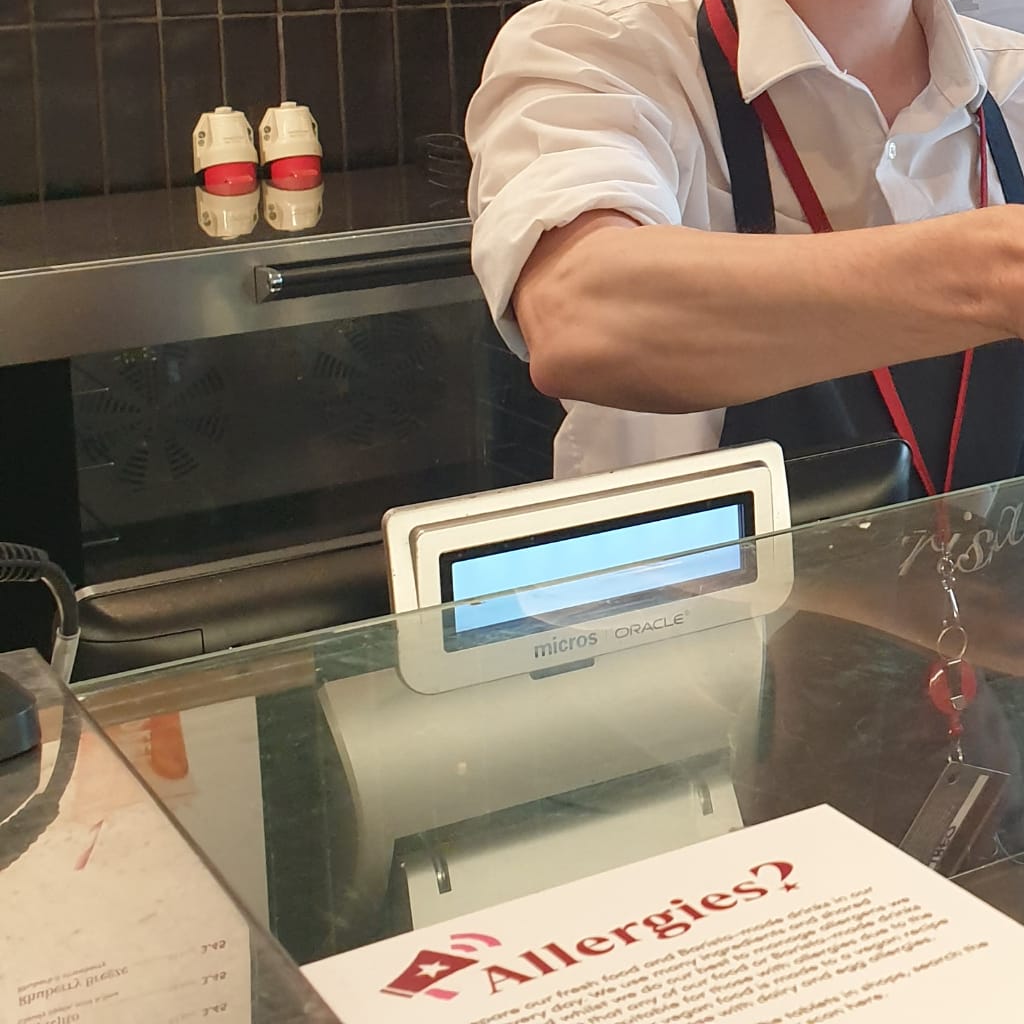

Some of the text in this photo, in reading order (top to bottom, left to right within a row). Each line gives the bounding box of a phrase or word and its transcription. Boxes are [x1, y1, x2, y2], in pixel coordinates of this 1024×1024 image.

[534, 632, 599, 659] micros
[481, 861, 799, 996] Allergies?
[525, 995, 553, 1010] our
[556, 981, 599, 997] fresh
[602, 964, 640, 982] food
[644, 953, 675, 968] and
[678, 917, 784, 957] Barista-made
[787, 902, 830, 919] drinks
[832, 895, 848, 903] in
[560, 1000, 608, 1021] whilst
[611, 993, 637, 1003] we
[641, 983, 663, 994] do
[666, 971, 691, 984] our
[695, 958, 730, 974] best
[732, 953, 750, 961] to
[753, 930, 817, 954] manage
[819, 905, 887, 931] allergens
[587, 987, 617, 997] We
[620, 976, 649, 988] use
[653, 958, 697, 977] many
[700, 928, 786, 960] ingredients
[789, 916, 818, 930] and
[588, 904, 921, 1024] that any of our food or Barista-made drinks
[683, 991, 706, 1004] for
[709, 976, 754, 993] those
[758, 963, 791, 977] with
[794, 939, 858, 965] allergies
[860, 928, 889, 941] due
[890, 921, 906, 929] to
[908, 912, 933, 922] the
[661, 1003, 714, 1024] vegan
[715, 986, 754, 1004] food
[757, 982, 770, 990] is
[773, 965, 818, 984] made
[821, 958, 838, 966] to
[855, 935, 901, 955] vegan
[720, 1001, 754, 1017] with
[757, 985, 798, 1003] dairy
[801, 971, 833, 987] and
[835, 961, 867, 975] egg
[841, 989, 858, 997] in
